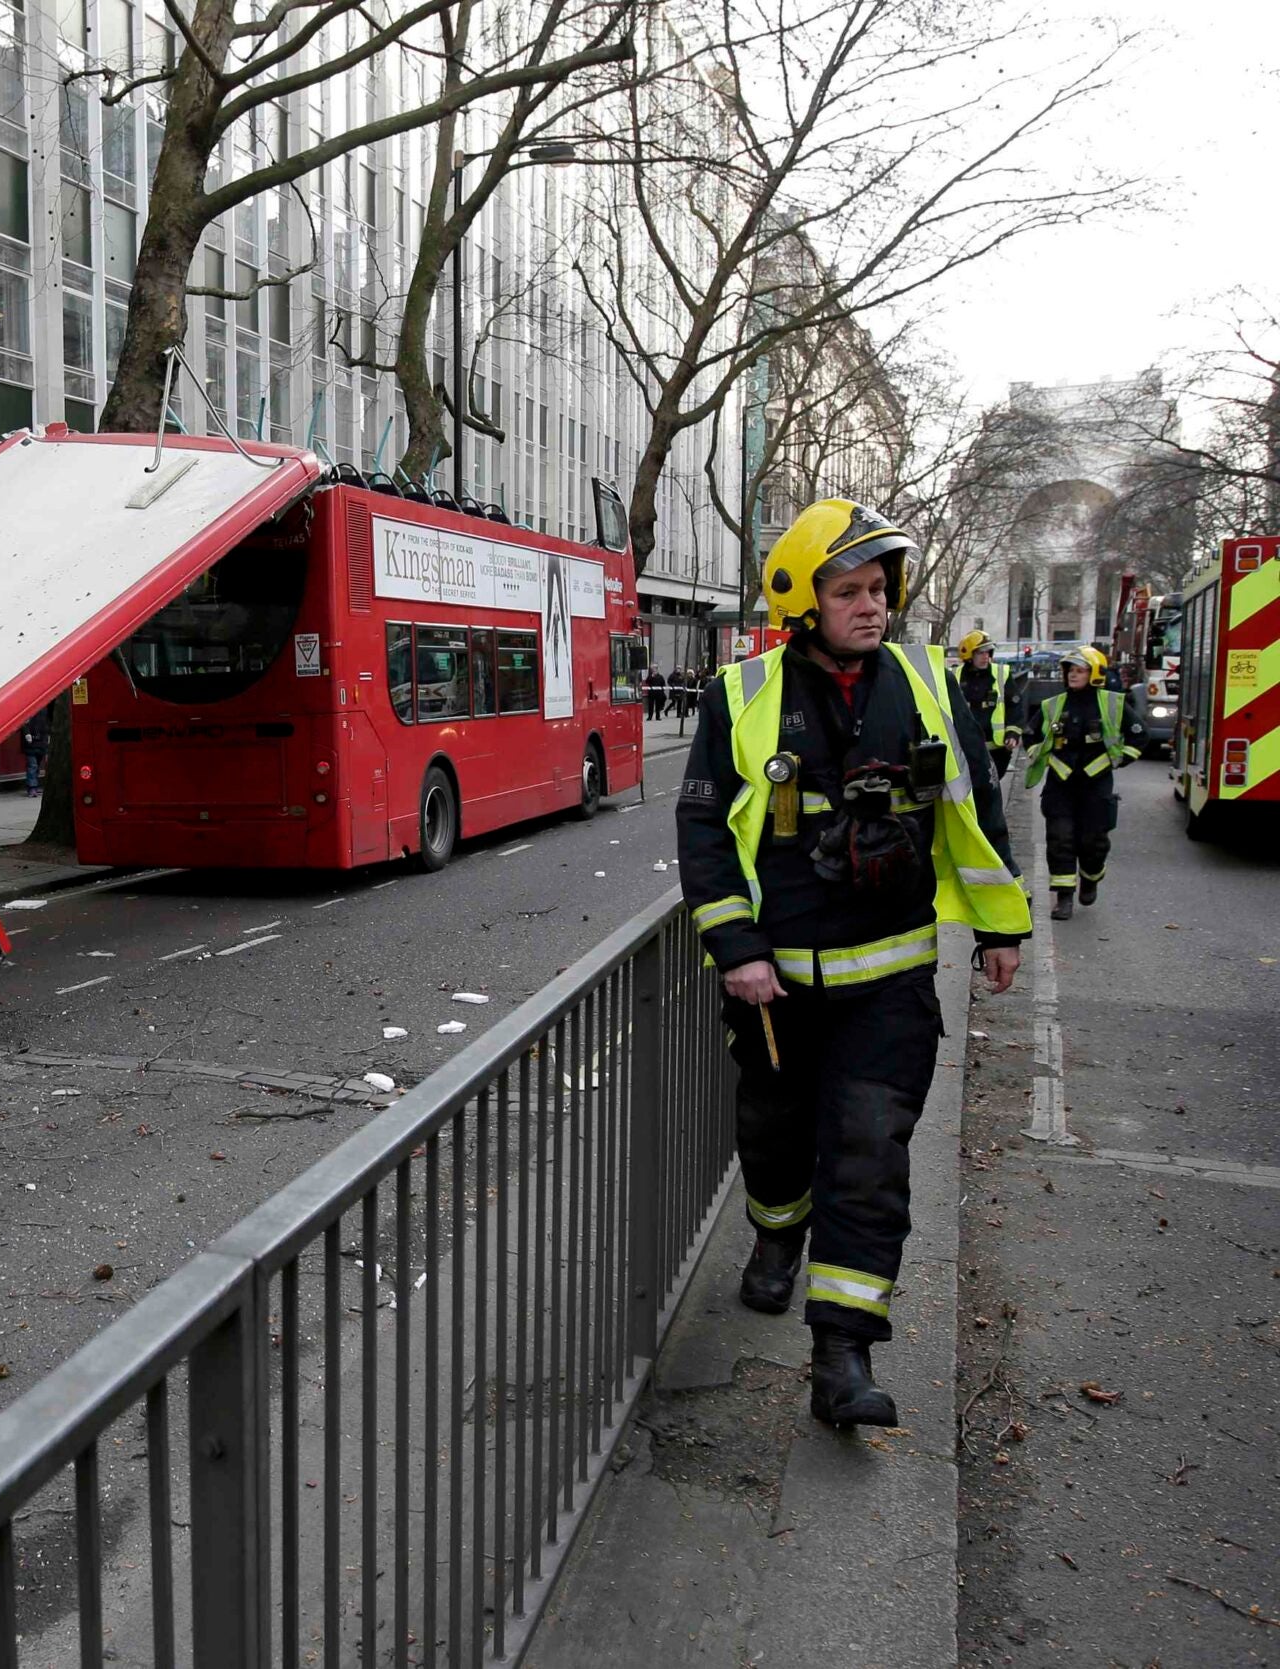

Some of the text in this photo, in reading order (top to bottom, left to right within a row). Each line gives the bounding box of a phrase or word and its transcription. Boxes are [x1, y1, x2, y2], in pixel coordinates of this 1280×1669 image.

[408, 534, 420, 544] FROM
[420, 537, 429, 546] THE
[384, 529, 477, 593] Kingsman
